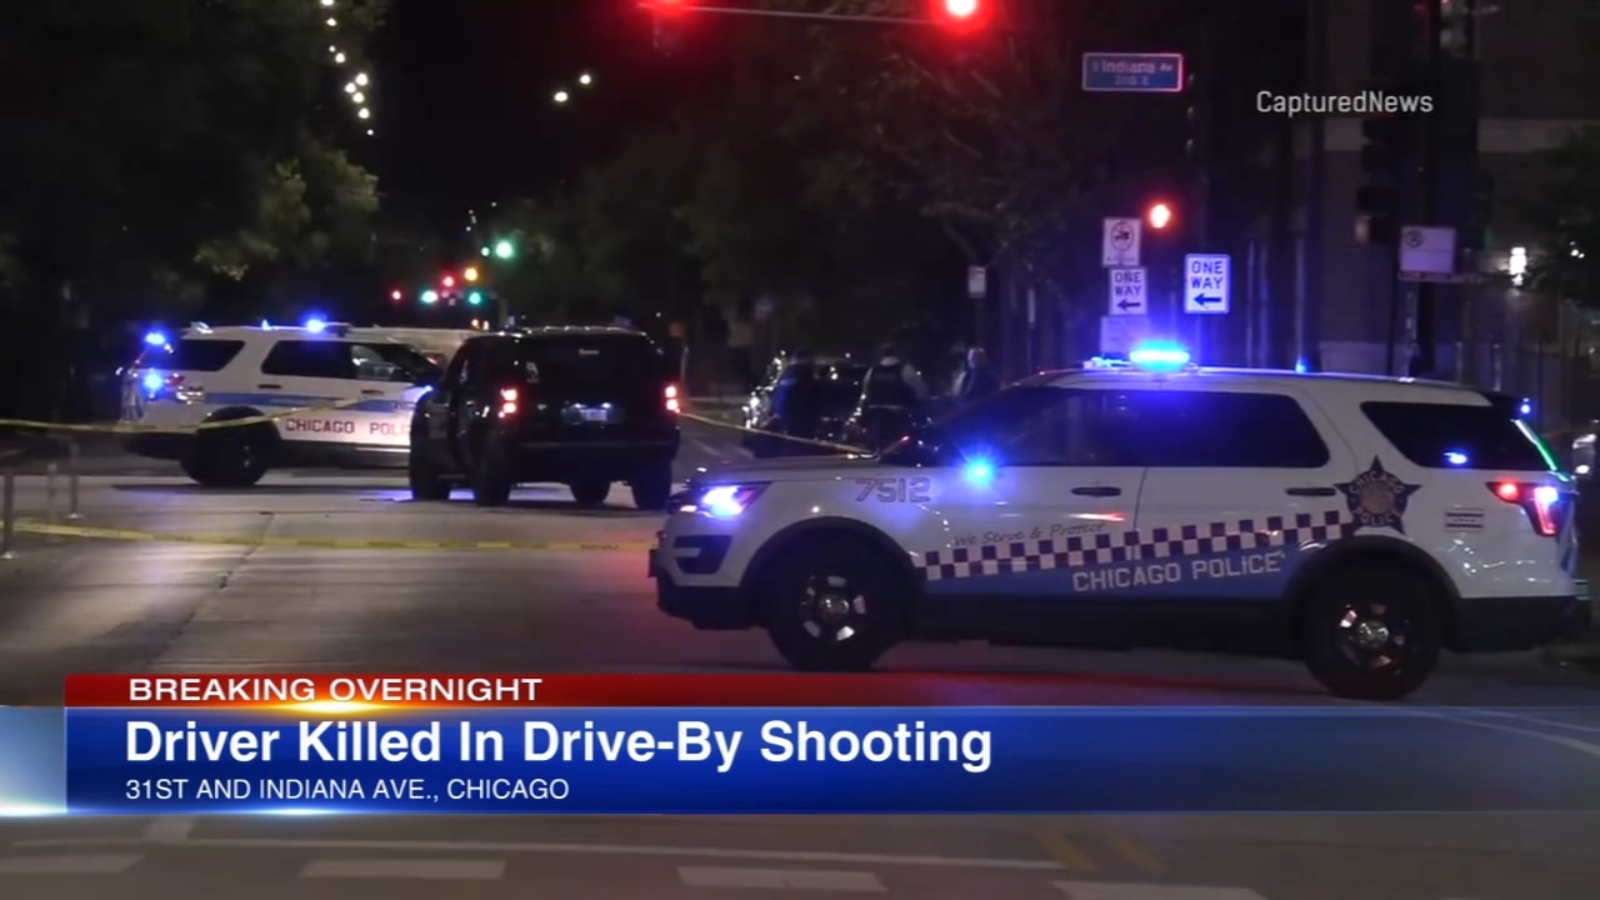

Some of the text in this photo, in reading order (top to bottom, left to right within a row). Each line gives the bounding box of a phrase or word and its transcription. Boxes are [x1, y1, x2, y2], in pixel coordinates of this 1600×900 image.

[1101, 60, 1156, 74] Indiana
[1191, 260, 1223, 274] ONE
[1114, 271, 1141, 283] ONE
[1190, 276, 1223, 289] WAY
[1114, 286, 1141, 296] WAY
[285, 418, 355, 434] CHICAGO
[855, 477, 931, 503] 7512
[984, 530, 1025, 544] Serve
[1072, 552, 1281, 592] CHICAGO POLICE
